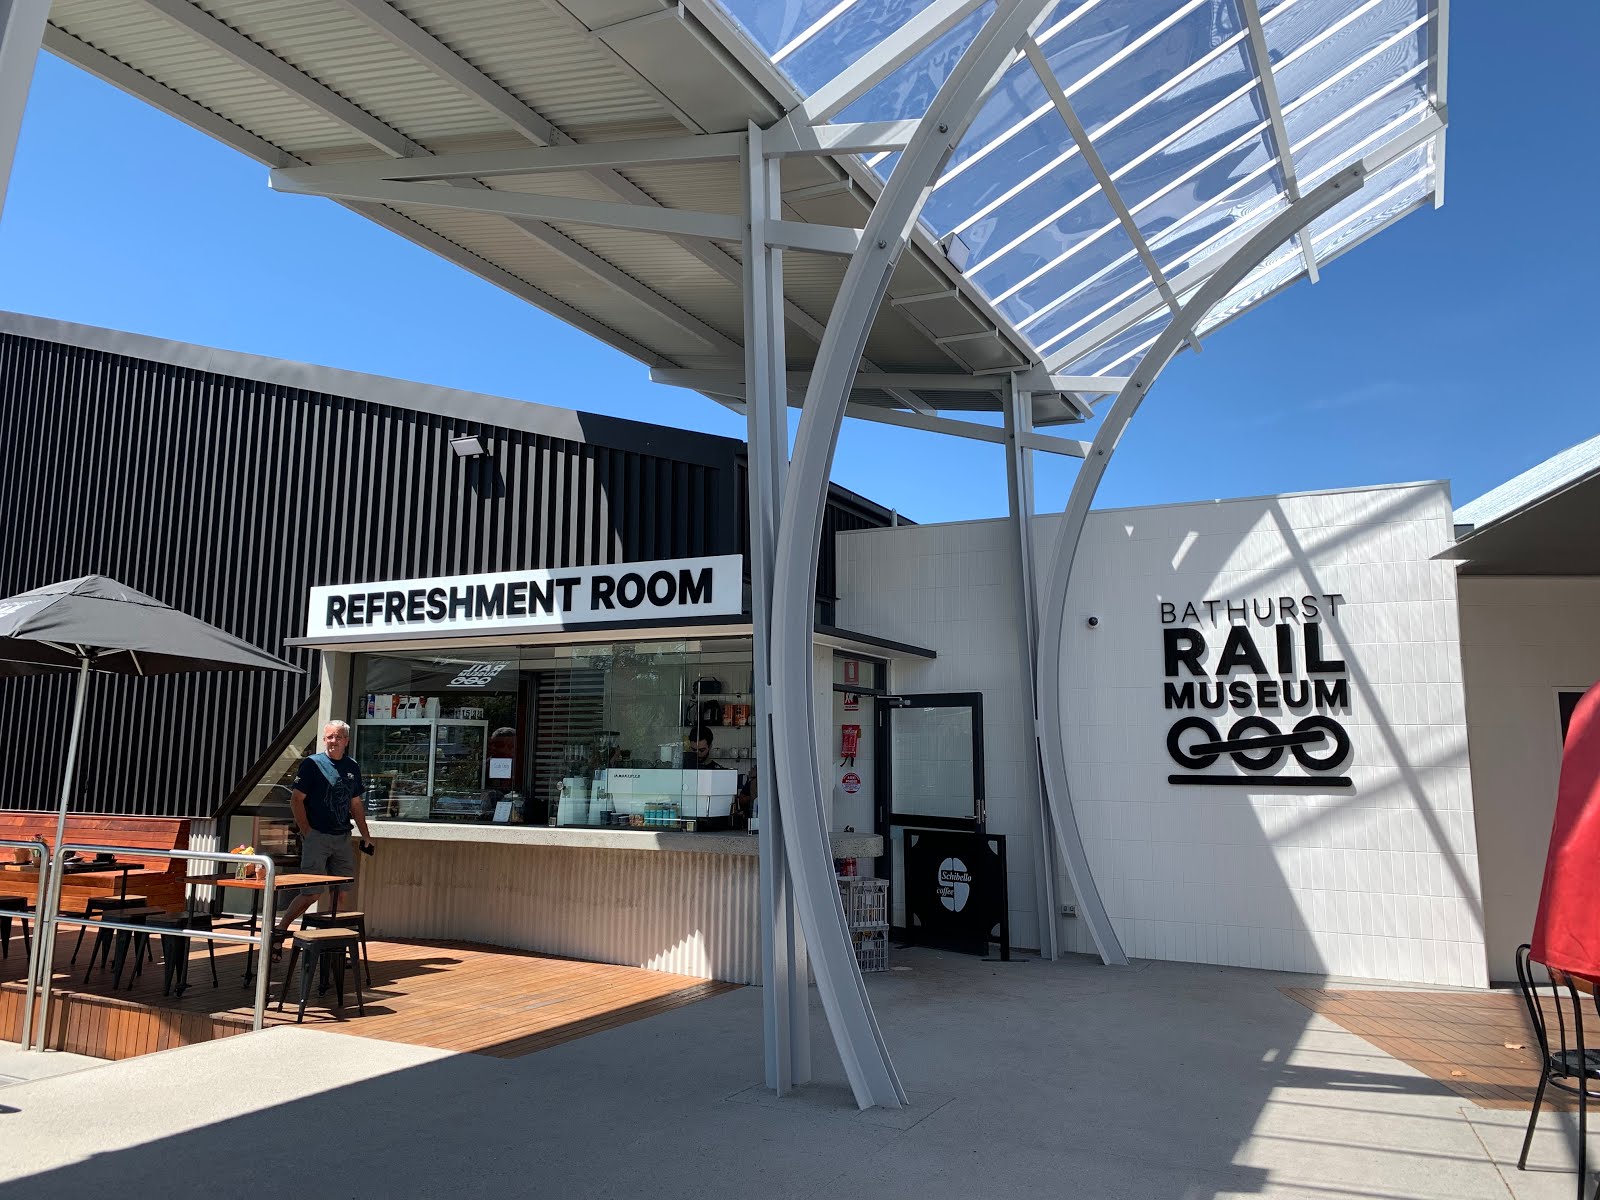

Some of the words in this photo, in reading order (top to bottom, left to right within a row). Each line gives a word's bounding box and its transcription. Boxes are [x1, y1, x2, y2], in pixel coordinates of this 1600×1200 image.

[326, 577, 582, 626] REFRESHMENT
[591, 567, 713, 611] ROOM
[1160, 594, 1343, 624] BATHURST
[1163, 622, 1346, 677] RAIL
[1164, 679, 1348, 709] MUSEUM
[936, 887, 953, 896] coffee
[942, 871, 971, 882] Schibello
